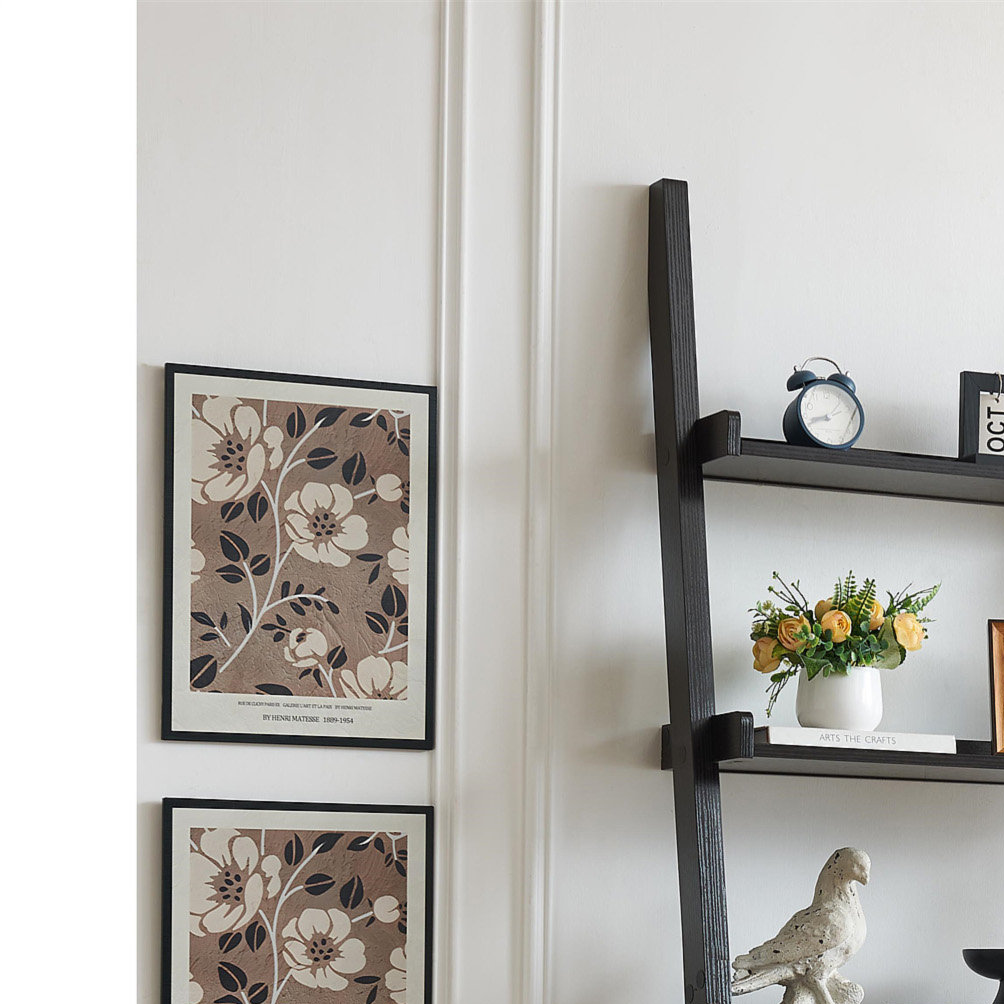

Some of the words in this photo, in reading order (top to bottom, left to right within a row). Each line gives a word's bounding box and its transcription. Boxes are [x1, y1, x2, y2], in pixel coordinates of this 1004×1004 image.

[819, 734, 840, 743] ARTS
[844, 734, 861, 743] THE
[864, 736, 897, 745] CRAFTS
